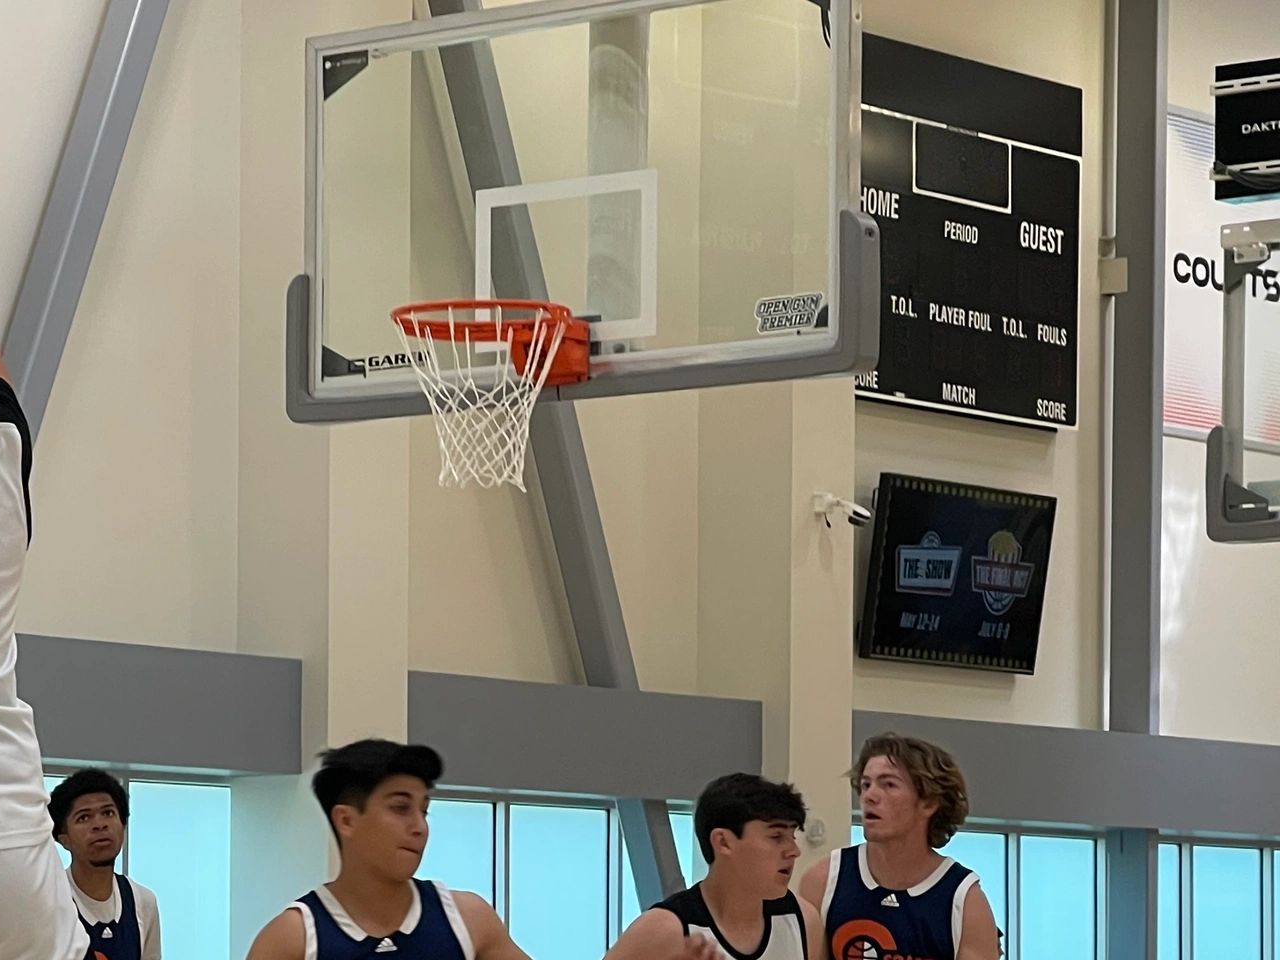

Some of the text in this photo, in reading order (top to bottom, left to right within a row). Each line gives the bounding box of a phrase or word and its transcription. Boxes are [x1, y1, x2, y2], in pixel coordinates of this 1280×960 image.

[1241, 120, 1280, 134] DAKT
[860, 186, 899, 219] HOME
[944, 220, 979, 244] PERIOD
[1020, 221, 1064, 255] GUEST
[1173, 253, 1280, 302] COUTS
[759, 299, 790, 314] OPEN
[890, 295, 918, 318] T.O.L.
[929, 303, 993, 332] PLAYER FOUL
[761, 311, 814, 330] PREMIER
[1002, 316, 1028, 338] T.O.L.
[1037, 323, 1067, 346] FOULS
[368, 350, 430, 367] GAR
[942, 382, 977, 405] MATCH
[1036, 398, 1067, 421] SCORE
[925, 559, 953, 579] SHOW
